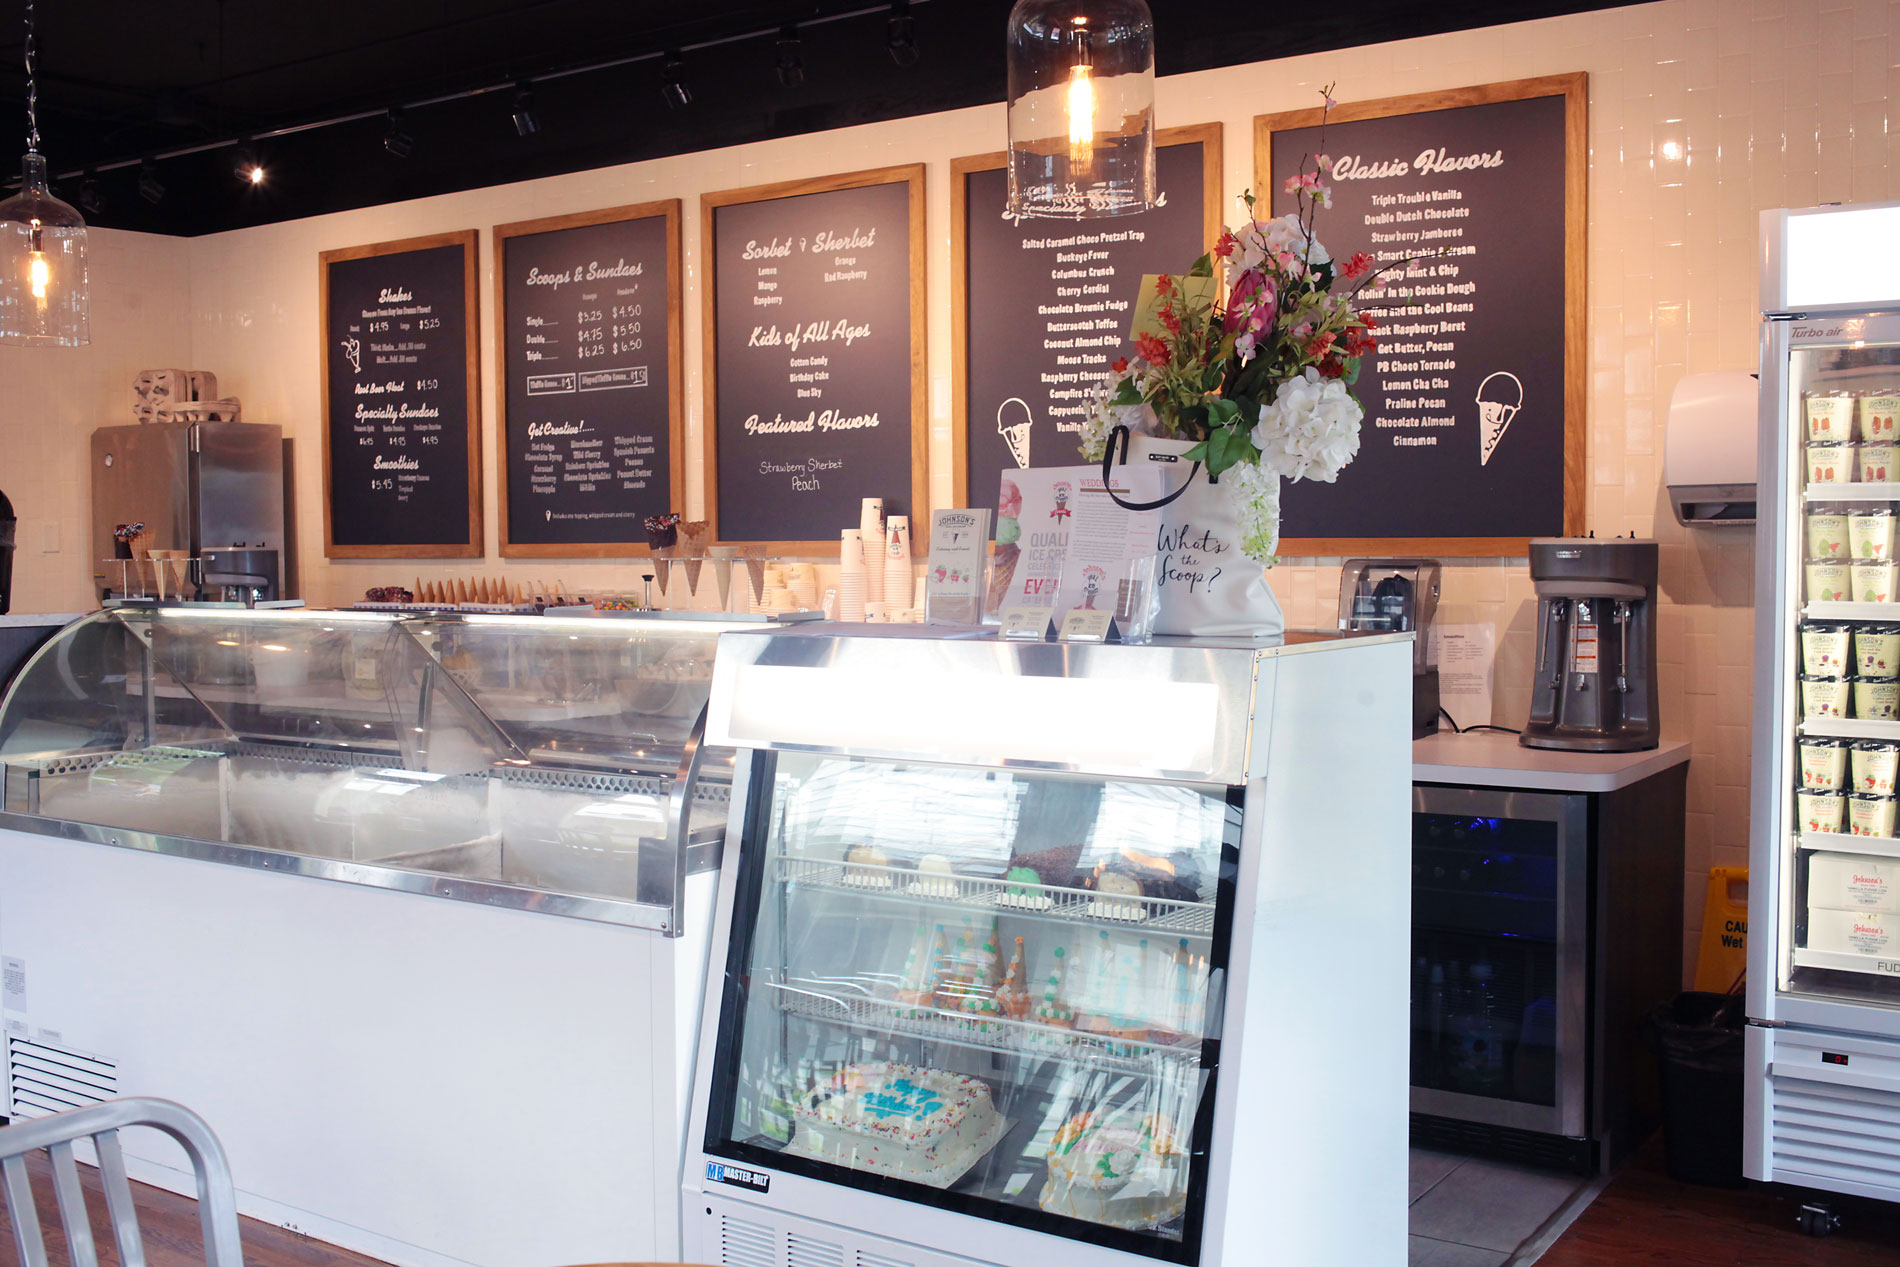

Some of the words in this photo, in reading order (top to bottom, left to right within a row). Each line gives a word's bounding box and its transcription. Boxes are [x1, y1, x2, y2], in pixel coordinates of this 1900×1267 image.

[1332, 155, 1409, 181] Classic
[1414, 147, 1504, 176] Flavors
[1372, 194, 1396, 207] Triple
[1397, 192, 1431, 205] Trouble
[1432, 190, 1462, 201] Vanilla
[1364, 213, 1394, 226] Double
[1396, 210, 1422, 222] Dutch
[1424, 208, 1470, 220] Chocolate
[1022, 238, 1045, 249] Salted
[1046, 236, 1076, 248] Caramel
[1076, 234, 1099, 245] Choco
[1100, 231, 1128, 242] Pretzel
[1128, 230, 1145, 243] Trap
[1371, 230, 1420, 243] Strawberry
[1420, 228, 1463, 240] Jamboree
[742, 237, 792, 260] Sorbet
[812, 227, 876, 253] Sherbet
[834, 257, 856, 266] Orange
[1057, 252, 1087, 264] Buckeye
[1088, 250, 1109, 261] Fever
[1377, 248, 1405, 262] Smart
[526, 267, 570, 290] Scoops
[574, 266, 583, 282] &
[586, 258, 643, 280] Sundaes
[758, 267, 777, 276] Lemon
[824, 272, 837, 283] Red
[837, 270, 868, 281] Raspberry
[1052, 269, 1087, 280] Columbus
[1089, 266, 1115, 277] Crunch
[1406, 266, 1428, 278] Mint
[1429, 266, 1437, 276] &
[1438, 265, 1459, 278] Chip
[758, 282, 778, 291] Mango
[1057, 286, 1081, 298] Cherry
[1082, 284, 1109, 295] Cordial
[1414, 285, 1445, 296] Cookie
[1446, 281, 1476, 295] Dough
[378, 287, 413, 303] Shakes
[754, 296, 782, 307] Raspberry
[612, 304, 641, 319] $4.50
[1038, 303, 1073, 315] Chocolate
[1074, 302, 1105, 313] Brownie
[1105, 300, 1128, 311] Fudge
[1407, 305, 1423, 316] the
[1424, 303, 1445, 314] Cool
[1445, 301, 1474, 313] Beans
[526, 317, 543, 327] Single
[1047, 320, 1094, 332] Butterscotch
[1095, 319, 1118, 329] Toffee
[1393, 323, 1439, 337] Raspberry
[1440, 321, 1466, 333] Beret
[526, 334, 545, 344] Double
[748, 325, 782, 347] Kids
[784, 323, 801, 352] of
[802, 320, 830, 344] All
[832, 319, 871, 347] Ages
[1791, 327, 1824, 338] Turbo
[1826, 327, 1843, 336] air
[612, 338, 642, 355] $6.50
[1044, 339, 1074, 349] Coconut
[1074, 337, 1102, 347] Almond
[1104, 336, 1121, 348] Chip
[1377, 343, 1394, 354] Get
[1426, 341, 1454, 352] Pecan
[526, 351, 542, 362] Triple
[790, 358, 810, 367] Cotton
[810, 356, 828, 366] Candy
[1057, 355, 1082, 366] Moose
[1082, 354, 1107, 364] Tracks
[1377, 361, 1390, 373] PB
[1391, 360, 1419, 372] Choco
[1420, 359, 1456, 370] Tornado
[790, 372, 814, 383] Birthday
[814, 371, 829, 381] Cake
[1041, 372, 1078, 384] Raspberry
[1382, 380, 1412, 391] Lemon
[1413, 378, 1430, 390] Cha
[1432, 378, 1449, 389] Cha
[797, 389, 810, 398] Blue
[810, 387, 822, 398] Sky
[1050, 388, 1082, 400] Campfire
[1385, 398, 1417, 409] Praline
[1418, 397, 1446, 408] Pecan
[355, 403, 398, 424] Specialty
[399, 403, 439, 419] Sundaes
[744, 411, 815, 436] Featured
[817, 409, 879, 432] Flavors
[1376, 416, 1420, 428] Chocolate
[1421, 416, 1455, 427] Almond
[528, 422, 543, 440] Get
[1393, 435, 1437, 447] Cinnamon
[373, 455, 419, 470] Smoothies
[759, 461, 805, 477] Strawberry
[807, 458, 843, 473] Sherbet
[792, 474, 820, 491] Peach
[1157, 524, 1230, 553] What's
[1181, 555, 1200, 566] the
[1158, 555, 1222, 594] Scoop?
[1722, 935, 1743, 949] Wet
[707, 1164, 724, 1180] MB
[724, 1166, 768, 1186] MASTER-BILT
